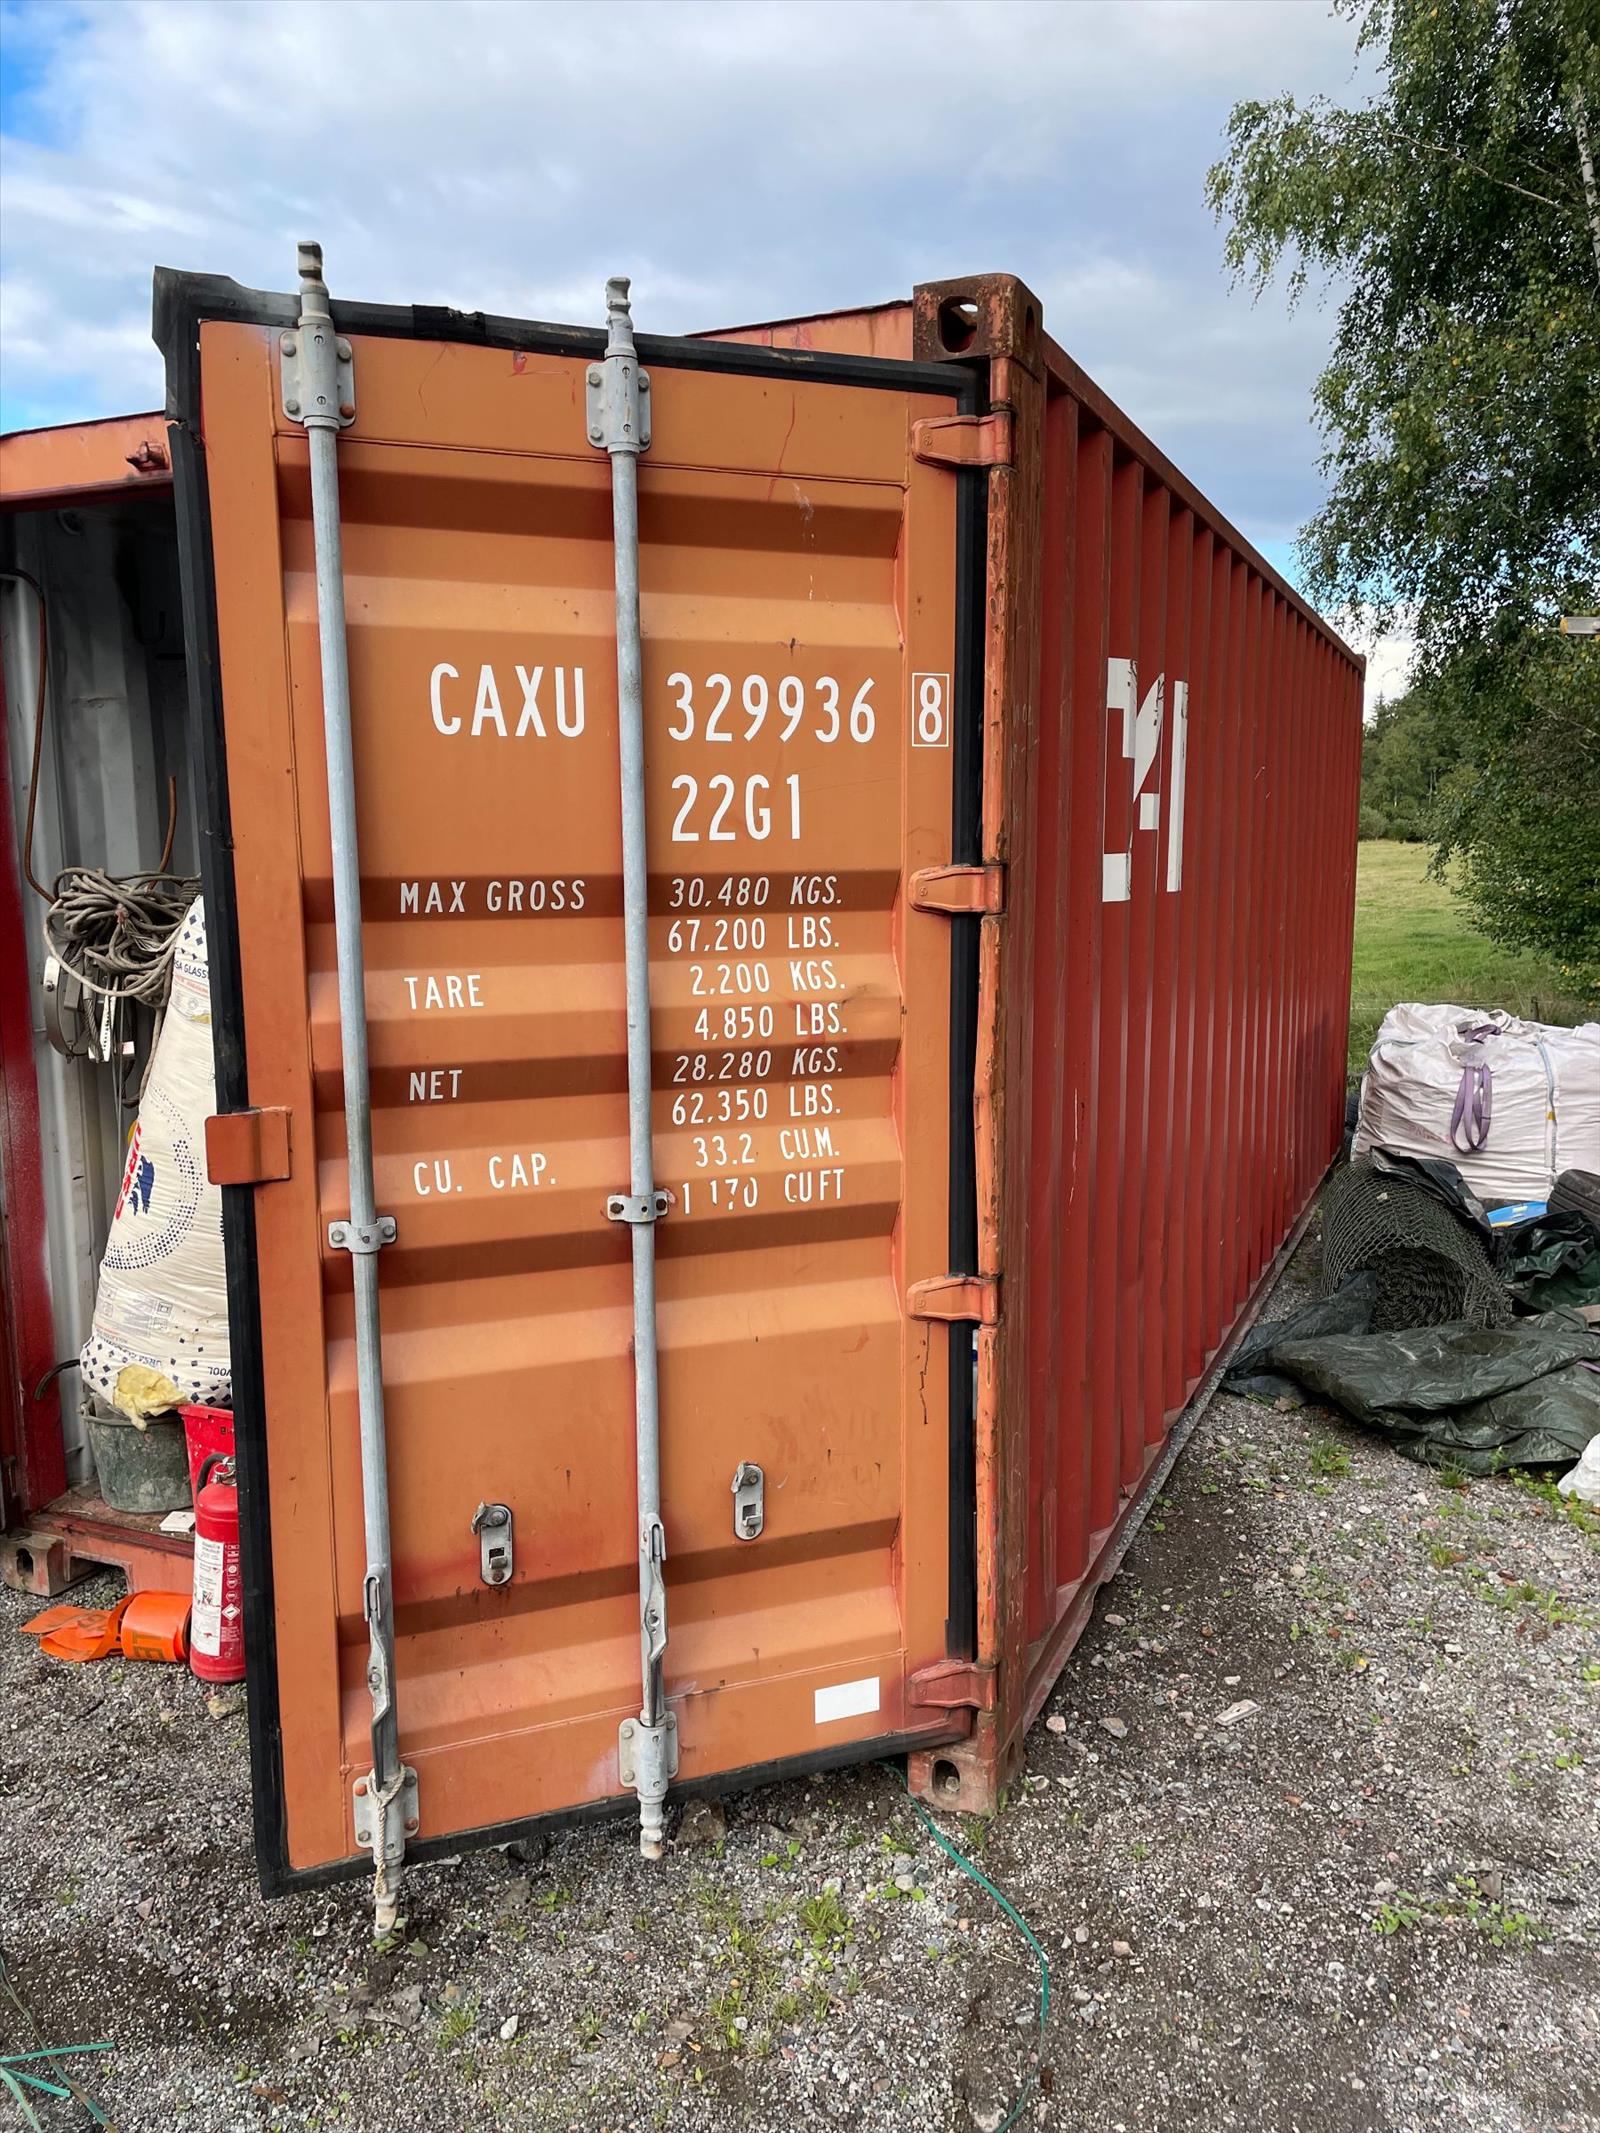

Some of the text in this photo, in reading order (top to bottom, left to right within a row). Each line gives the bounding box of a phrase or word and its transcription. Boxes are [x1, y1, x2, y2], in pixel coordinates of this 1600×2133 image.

[430, 662, 942, 743] CAXU 329936 8
[671, 774, 801, 842] 22G1
[400, 875, 842, 914] MAX GROSS 30,480 KGS.
[668, 916, 839, 953] 67,200 LBS.
[404, 959, 845, 1010] TARE 2,200 KGS.
[694, 1003, 847, 1041] 4,850 LBS.
[409, 1046, 843, 1101] NET 28,280 KGS.
[672, 1083, 841, 1125] 62,350 LBS.
[413, 1126, 840, 1195] CU. CAP. 33.2 CU.M.
